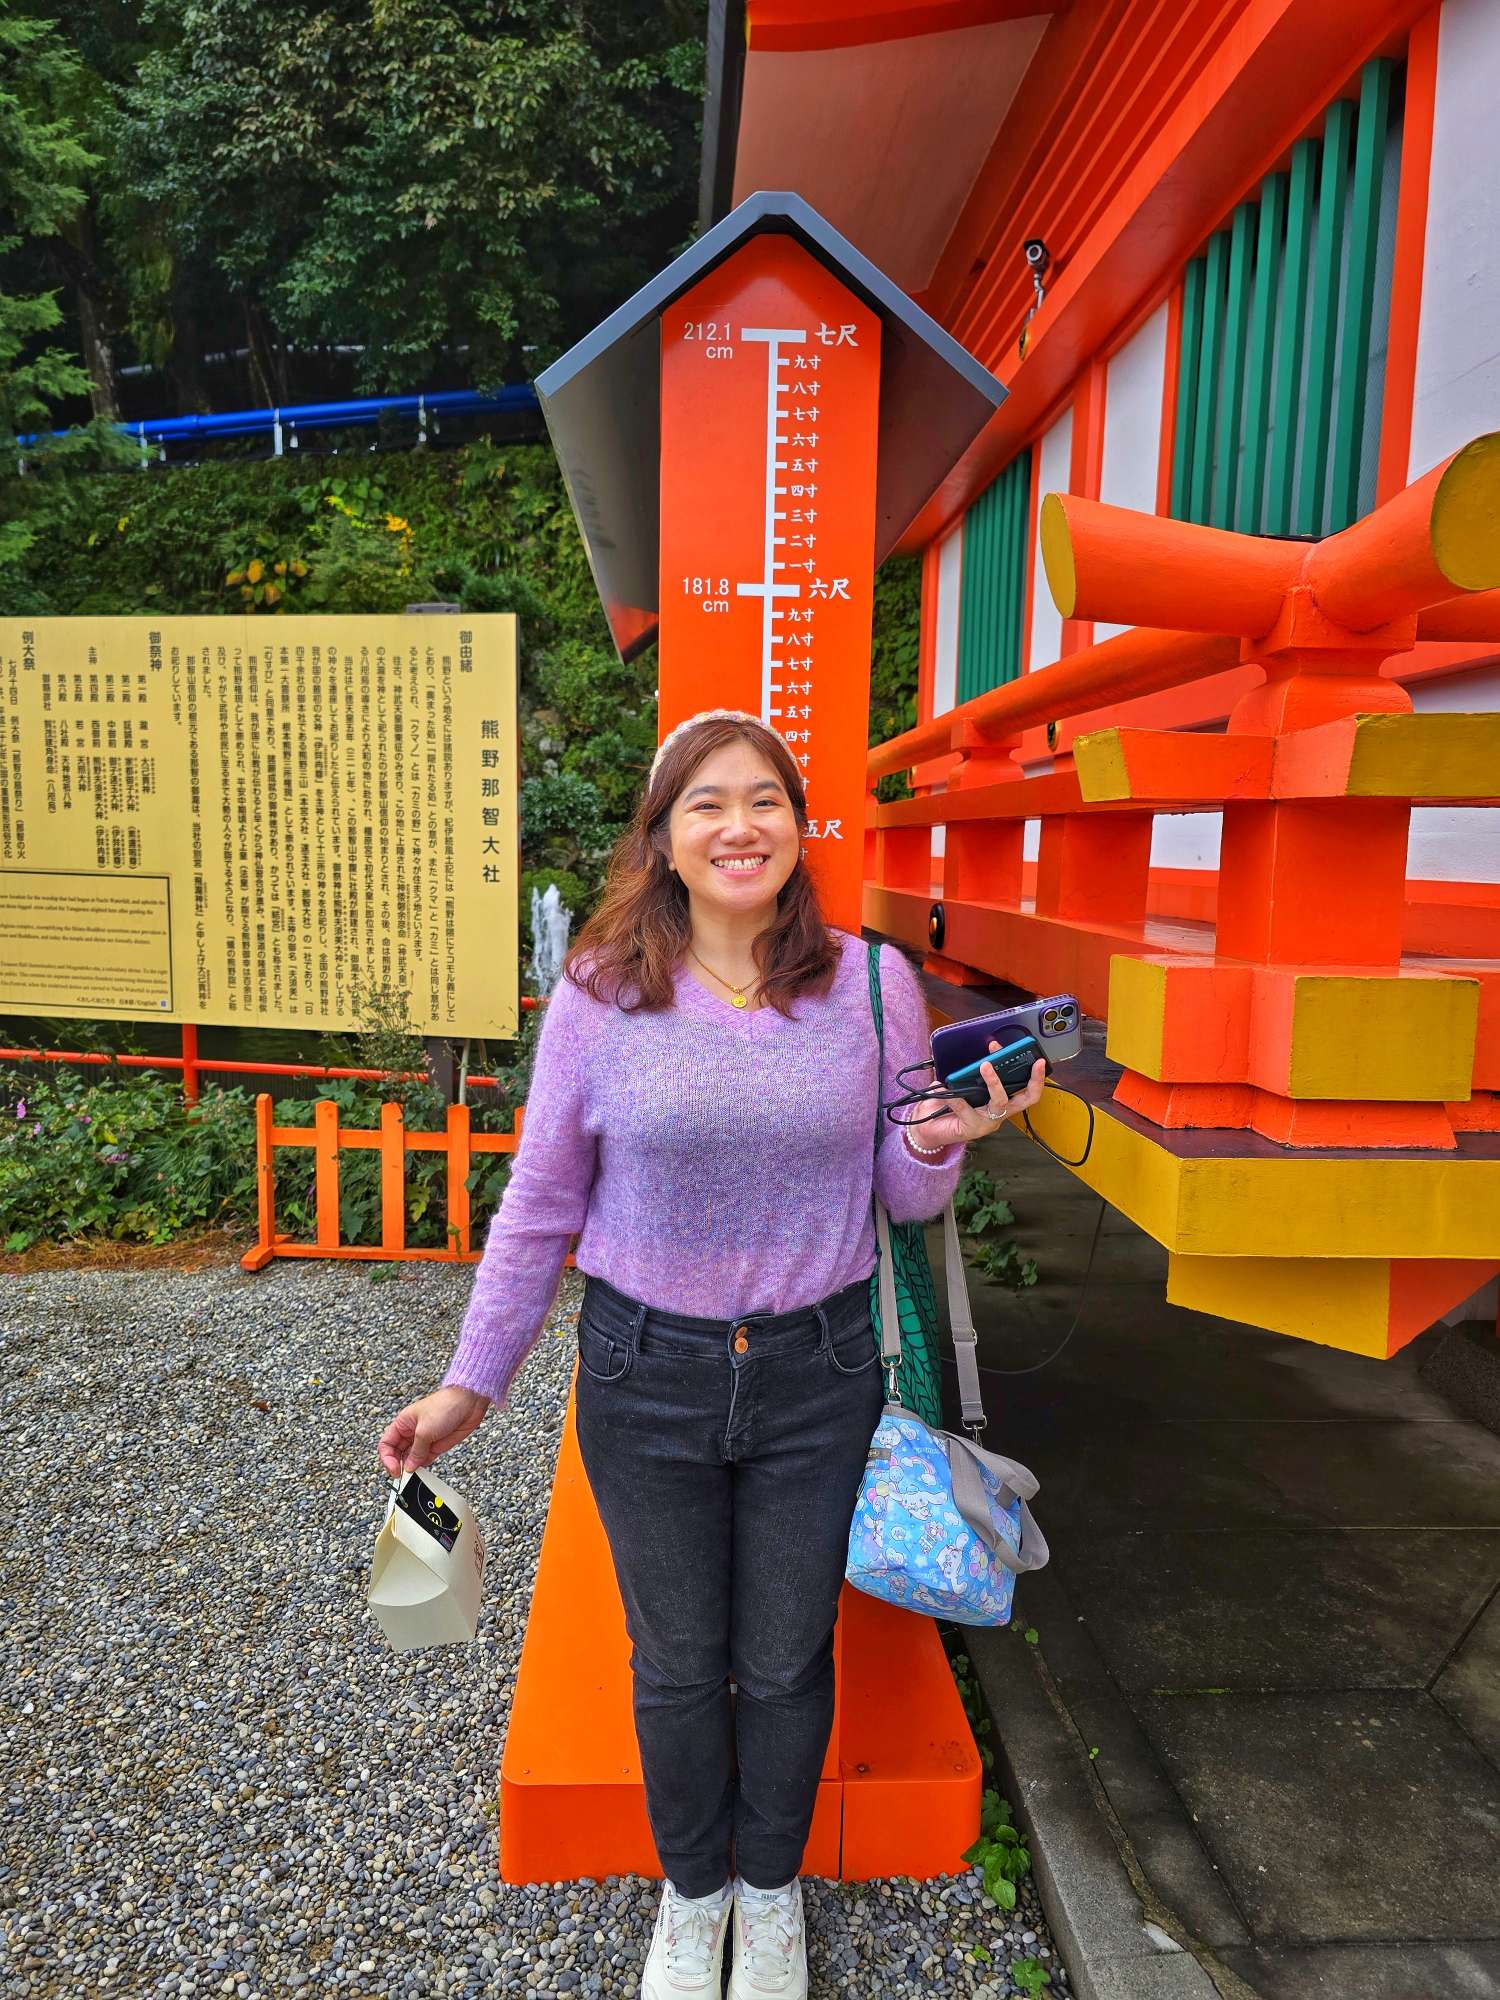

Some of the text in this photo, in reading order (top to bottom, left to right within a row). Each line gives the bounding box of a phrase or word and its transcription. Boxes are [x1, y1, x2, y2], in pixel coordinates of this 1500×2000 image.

[684, 322, 731, 341] 212.1
[815, 323, 859, 347] 七尺
[705, 345, 733, 359] cm
[794, 355, 821, 370] 九寸
[792, 381, 821, 396] 八寸
[792, 407, 820, 422] 七寸
[792, 433, 819, 448] 六寸
[791, 458, 819, 473] 五寸
[791, 484, 818, 499] 四寸
[790, 509, 817, 524] 三寸
[790, 534, 817, 549] 二寸
[789, 559, 816, 574] 一寸
[682, 577, 729, 596] 181.8
[809, 578, 851, 600] 六尺
[702, 599, 729, 613] cm
[787, 608, 814, 623] 九寸
[786, 633, 814, 648] 八寸
[21, 631, 36, 671] 例大祭
[148, 631, 162, 672] 御祭神
[459, 630, 472, 673] 御由緒
[786, 657, 813, 672] 七寸
[8, 659, 18, 705] 七月十四日
[57, 673, 67, 702] 第六殿
[73, 674, 83, 702] 第五殿
[89, 674, 99, 702] 第四殿
[105, 674, 115, 703] 第三殿
[121, 674, 131, 703] 第二殿
[137, 674, 147, 703] 第一殿
[786, 682, 813, 697] 六寸
[785, 706, 812, 721] 五寸
[785, 729, 812, 744] 四寸
[481, 719, 500, 883] 熊野那智大社
[802, 818, 844, 840] 五尺
